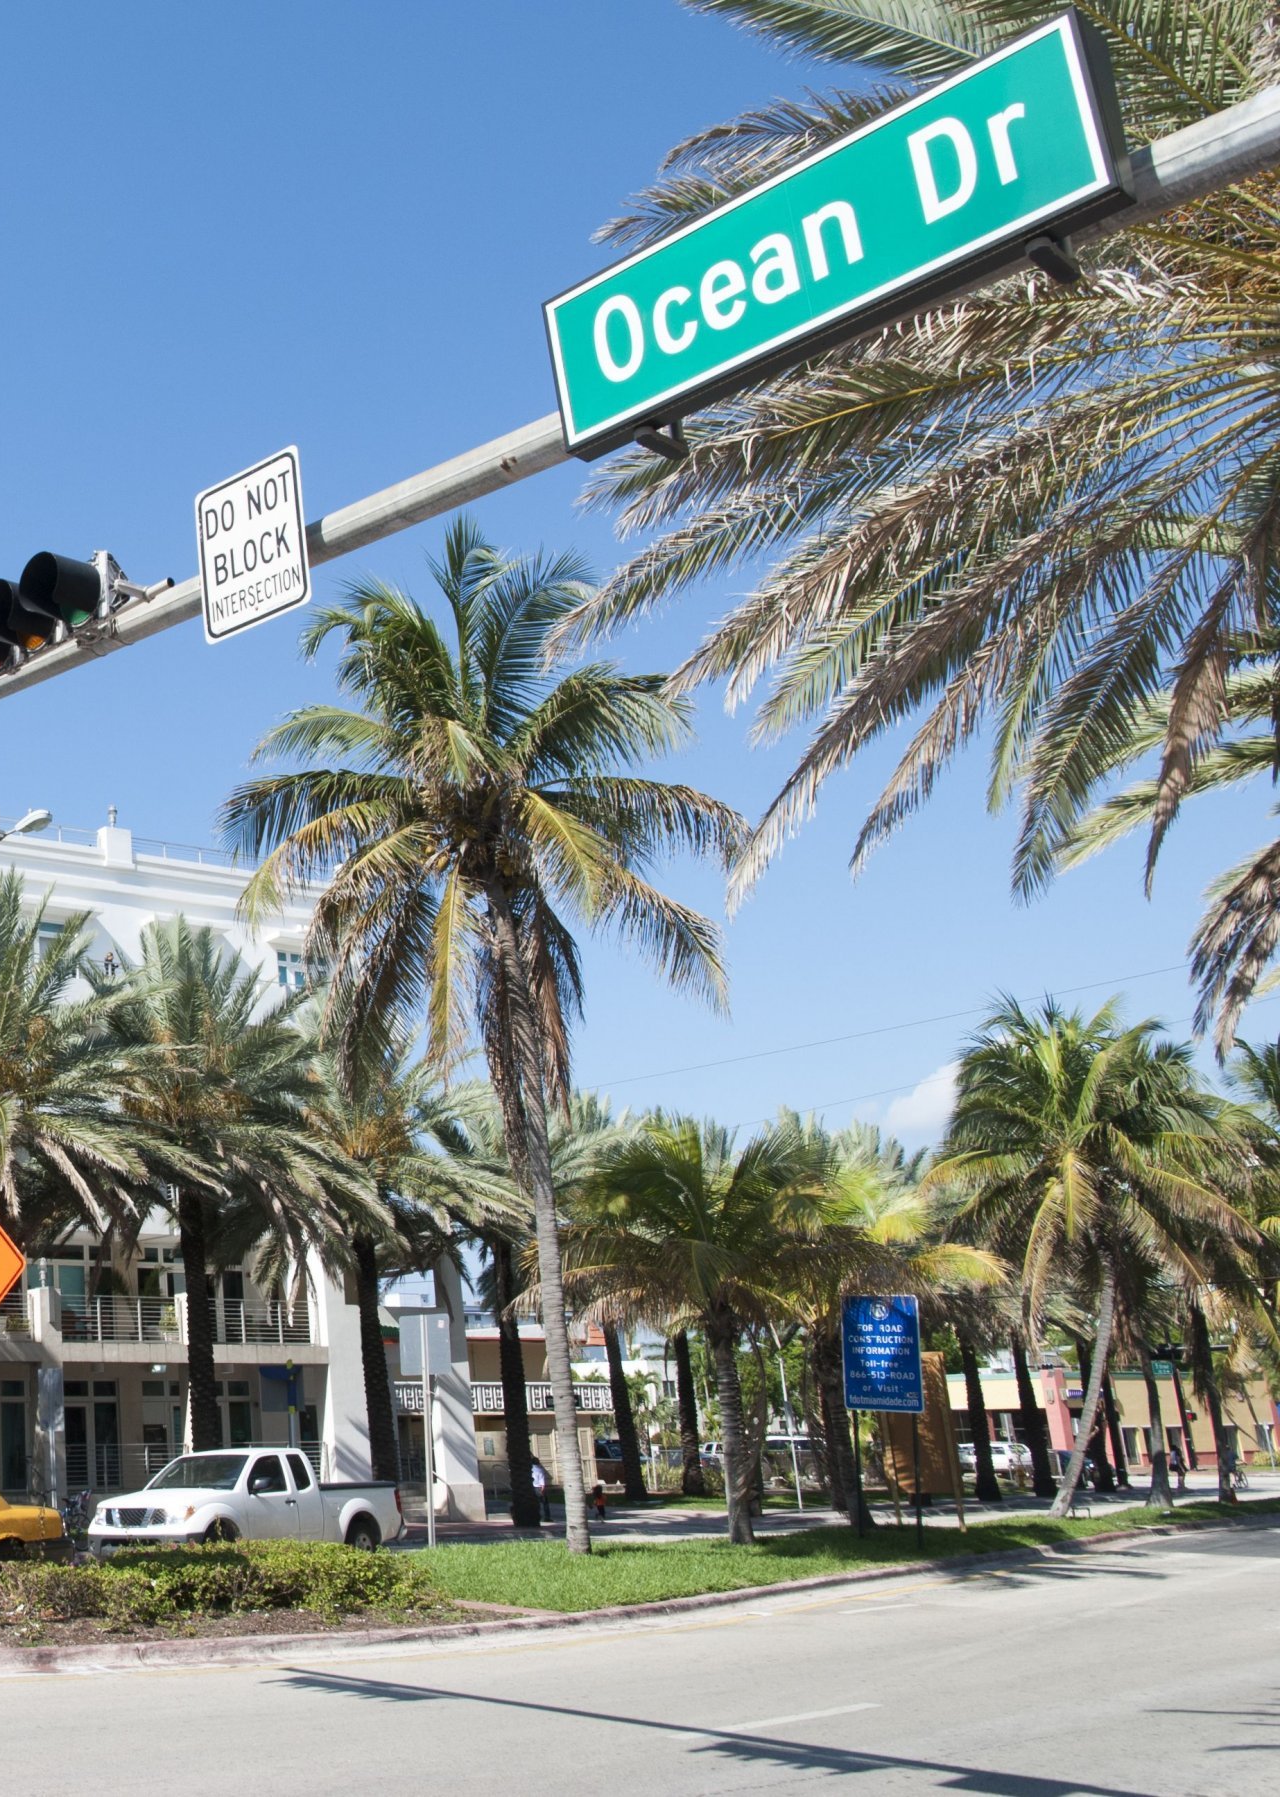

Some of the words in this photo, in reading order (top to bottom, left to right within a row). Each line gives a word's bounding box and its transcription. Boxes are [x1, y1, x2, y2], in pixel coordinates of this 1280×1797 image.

[593, 199, 864, 383] Ocean
[907, 102, 1025, 225] Dr
[205, 499, 235, 540] DO
[246, 469, 290, 520] NOT
[213, 522, 291, 586] BLOCK
[211, 564, 302, 623] INTERSECTION
[852, 1347, 910, 1355] INFORMATION
[857, 1324, 873, 1332] FOR
[879, 1324, 904, 1333] ROAD
[850, 1370, 915, 1379] 866-513-ROAD
